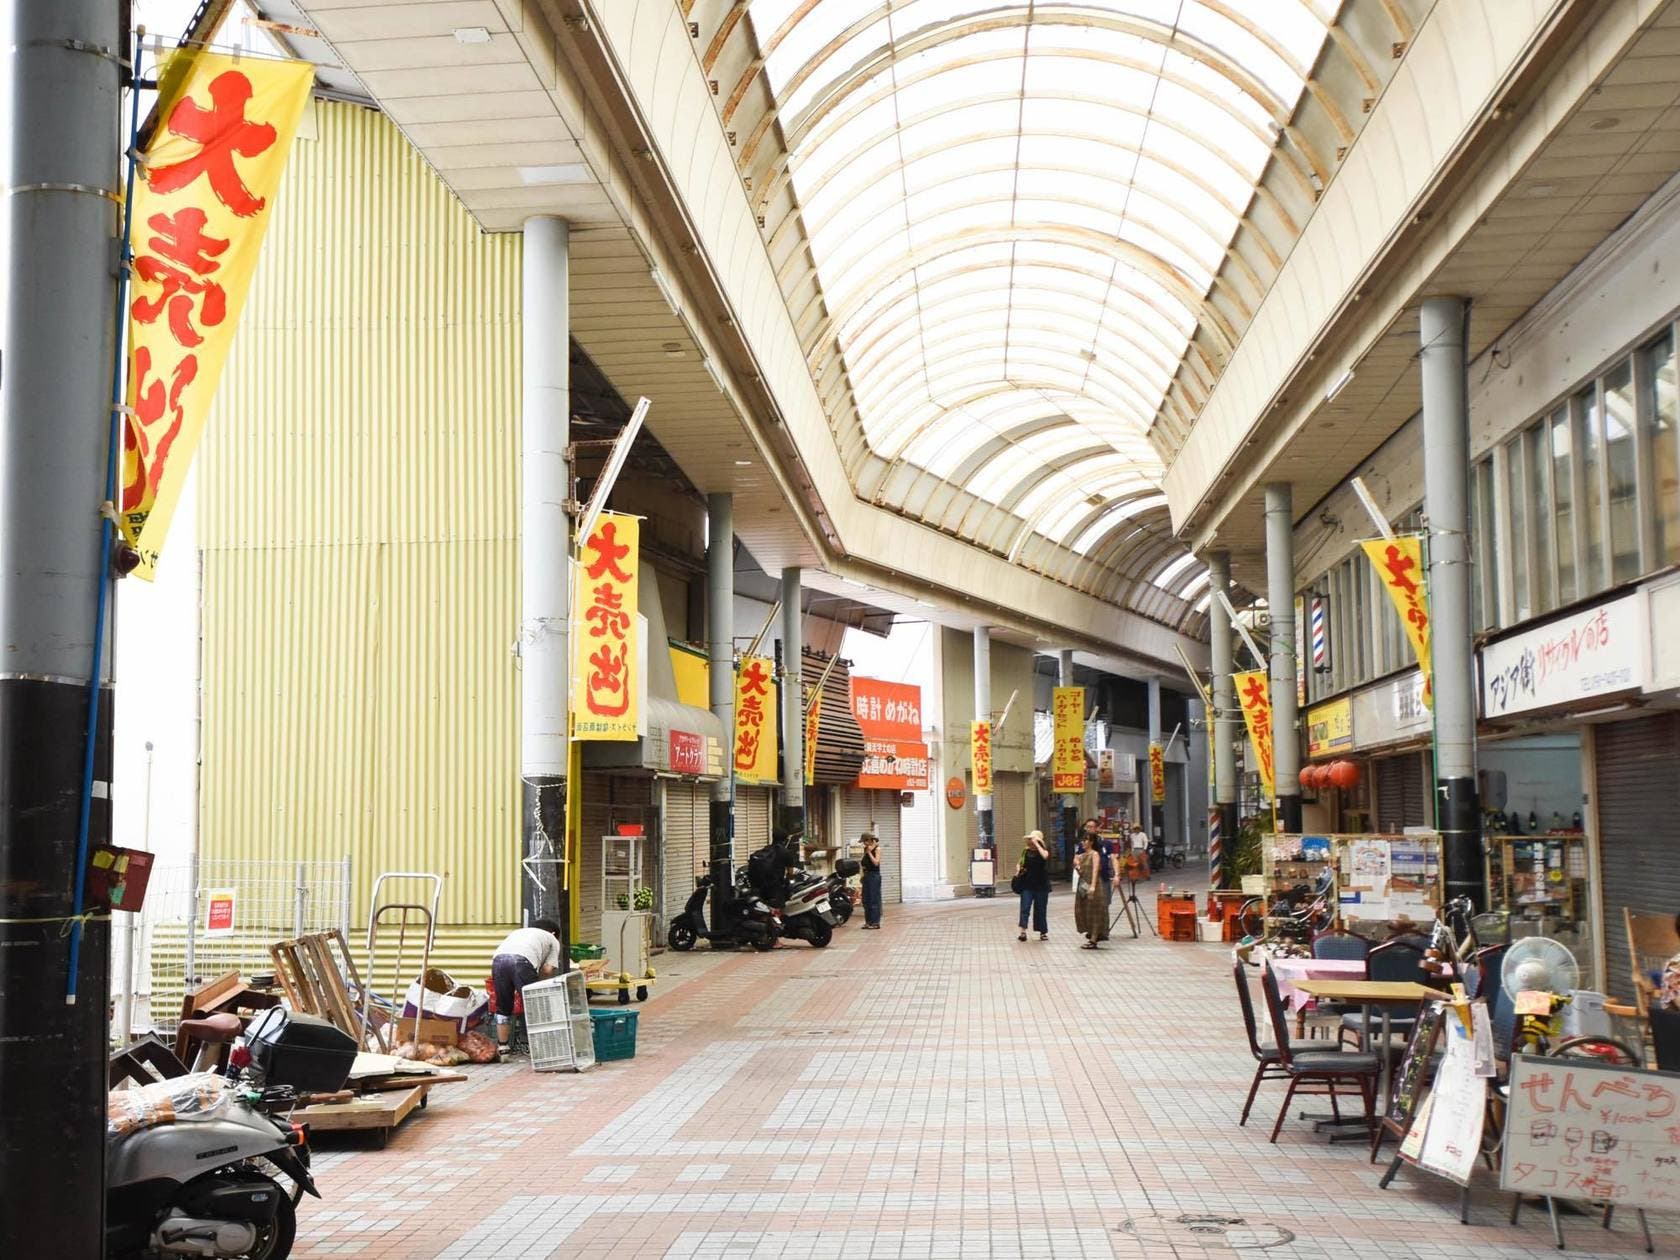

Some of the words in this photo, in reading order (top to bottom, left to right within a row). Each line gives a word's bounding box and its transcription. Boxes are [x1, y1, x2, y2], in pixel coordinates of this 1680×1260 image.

[856, 695, 881, 721] 時計
[885, 698, 920, 725] めがね
[1520, 1072, 1677, 1119] せんべろ
